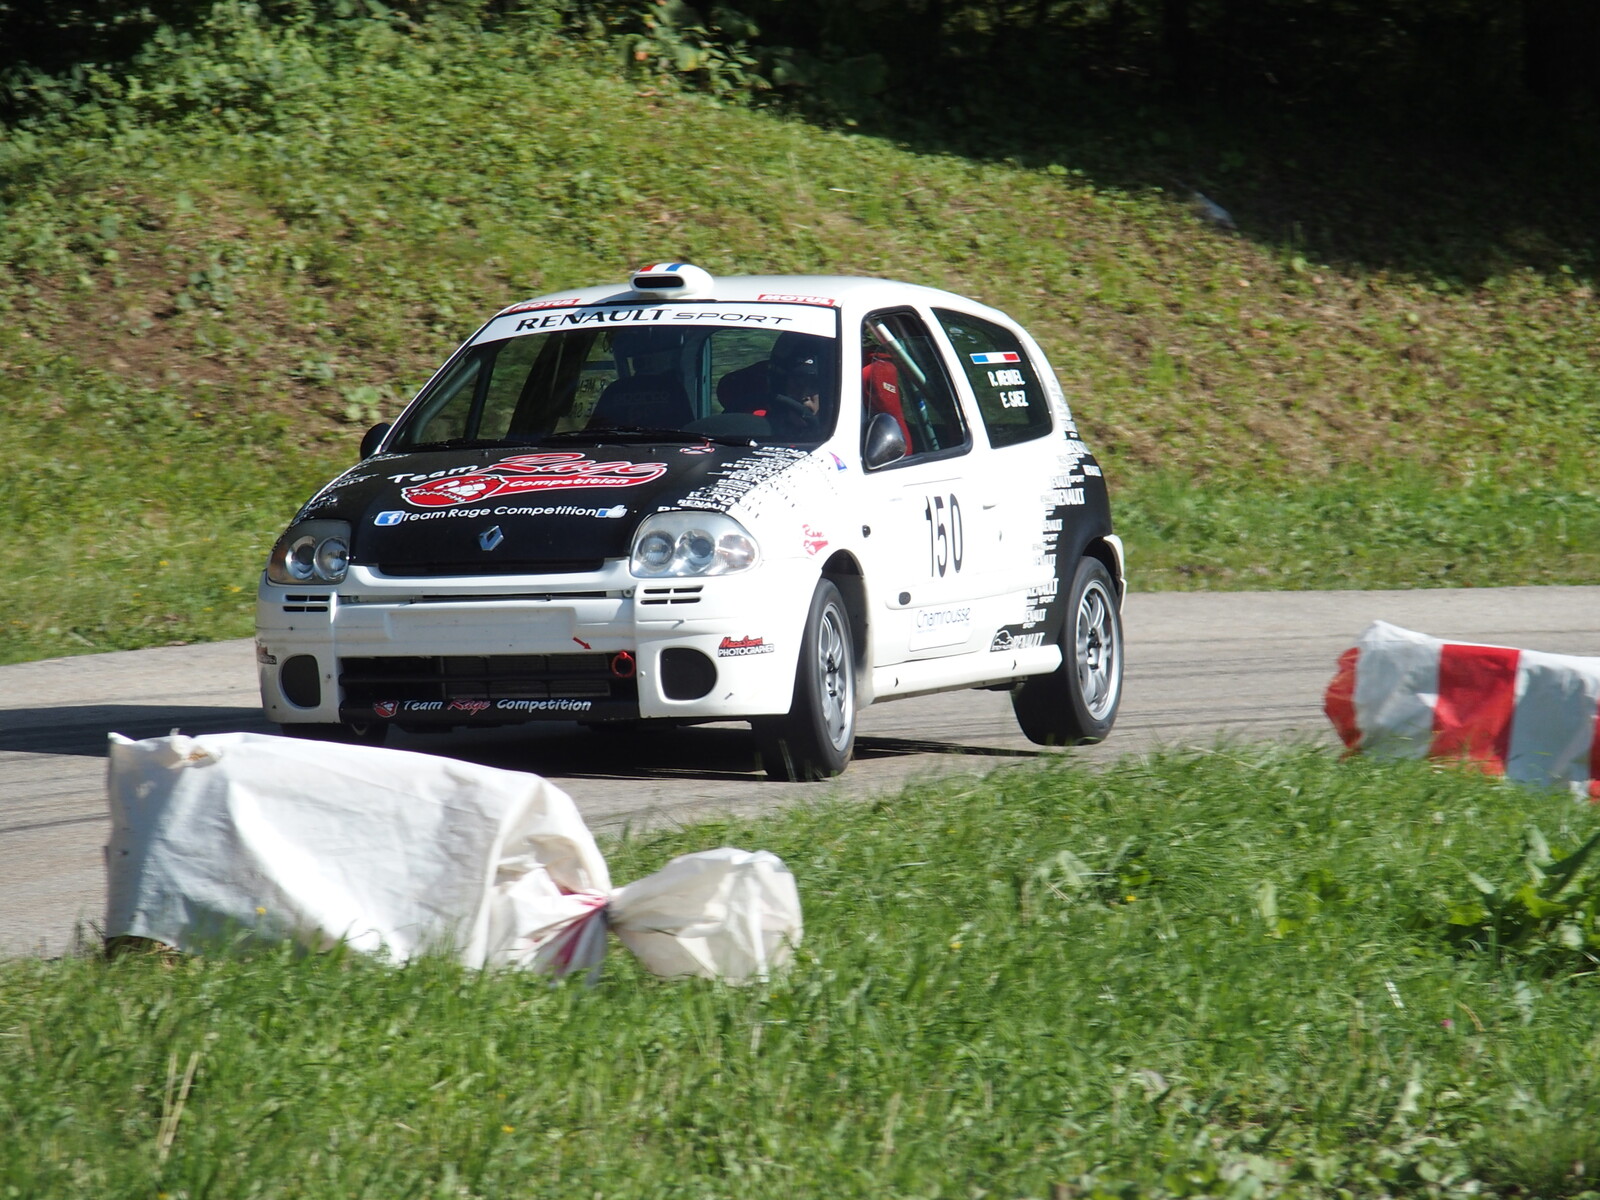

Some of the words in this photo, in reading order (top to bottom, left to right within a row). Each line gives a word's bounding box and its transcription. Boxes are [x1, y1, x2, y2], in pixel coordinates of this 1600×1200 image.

[761, 294, 833, 306] MOTUL
[514, 308, 673, 333] RENAULT
[672, 312, 793, 325] SPORT
[387, 465, 479, 484] Team
[508, 477, 630, 488] Competition
[403, 509, 446, 522] Team
[447, 508, 491, 519] Rage
[493, 504, 597, 517] Competition
[925, 492, 963, 579] 150
[403, 699, 443, 711] Team
[496, 698, 592, 713] Competition
